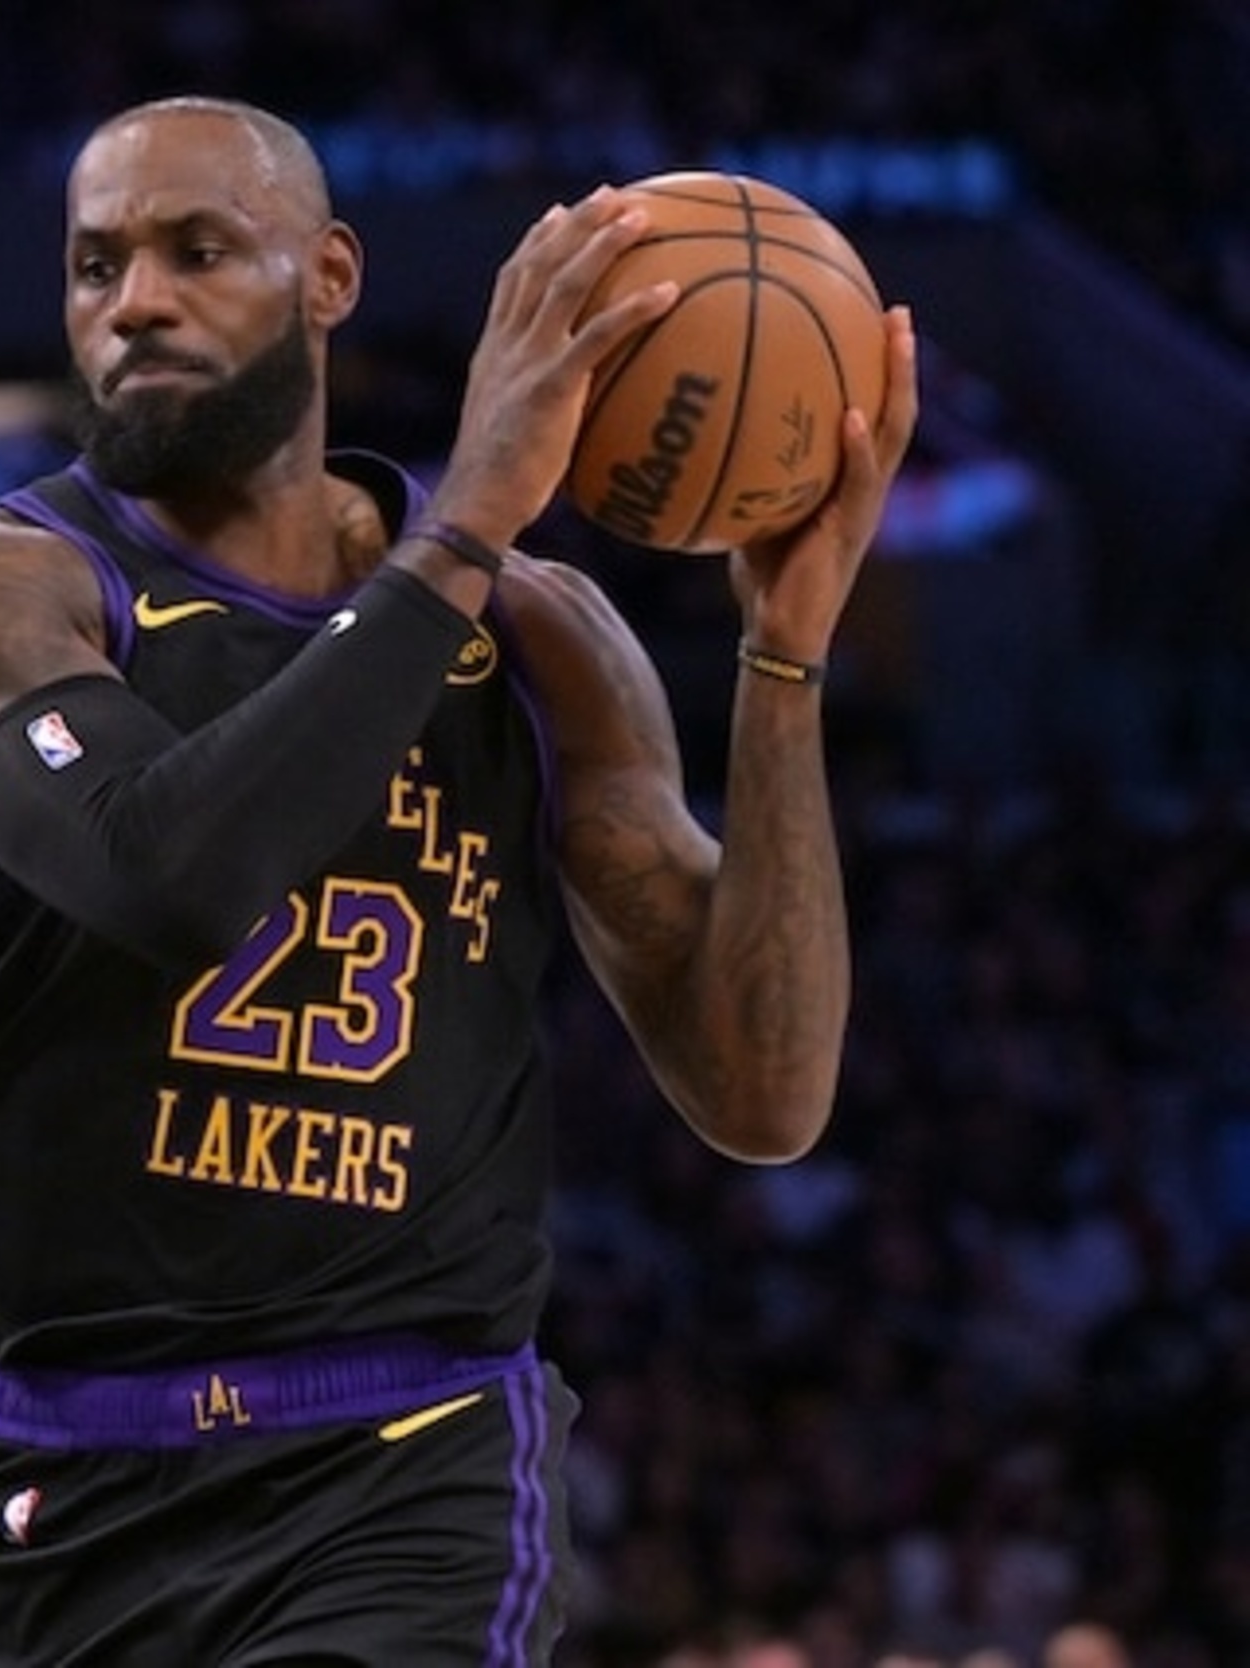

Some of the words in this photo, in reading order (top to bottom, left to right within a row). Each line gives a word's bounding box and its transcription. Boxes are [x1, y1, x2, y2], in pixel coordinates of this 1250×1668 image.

[170, 876, 422, 1083] 23
[147, 1089, 411, 1212] LAKERS
[191, 1373, 252, 1431] LAL
